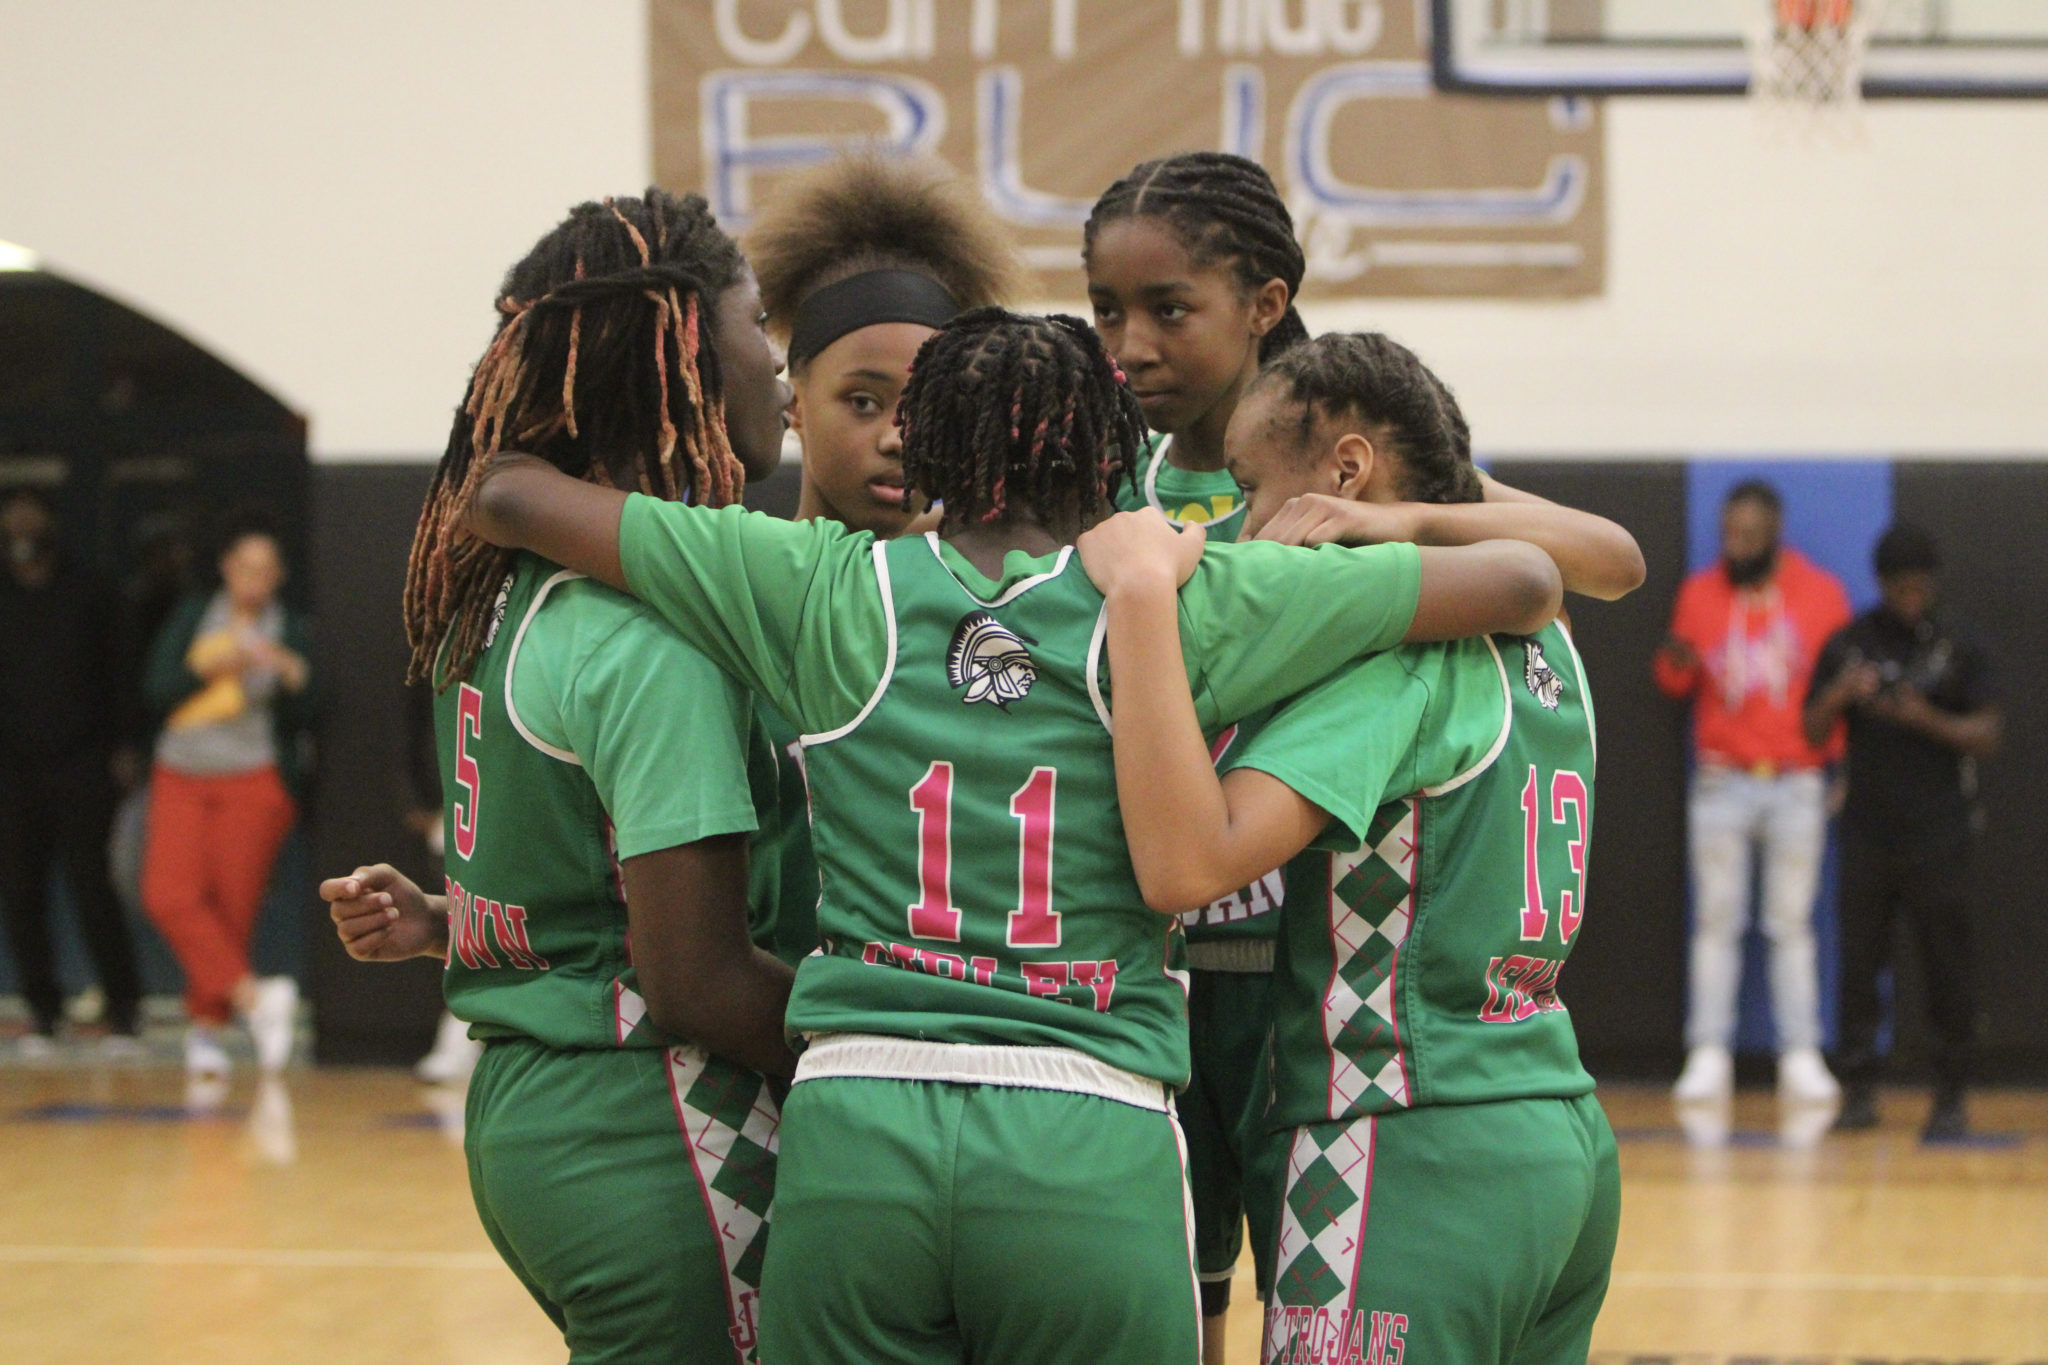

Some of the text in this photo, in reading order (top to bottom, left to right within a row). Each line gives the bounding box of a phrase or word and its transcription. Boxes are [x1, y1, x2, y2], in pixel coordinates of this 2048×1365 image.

[453, 681, 483, 862] 5
[907, 760, 1062, 949] 11
[1519, 763, 1588, 945] 13
[1281, 1305, 1409, 1365] TROJANS
